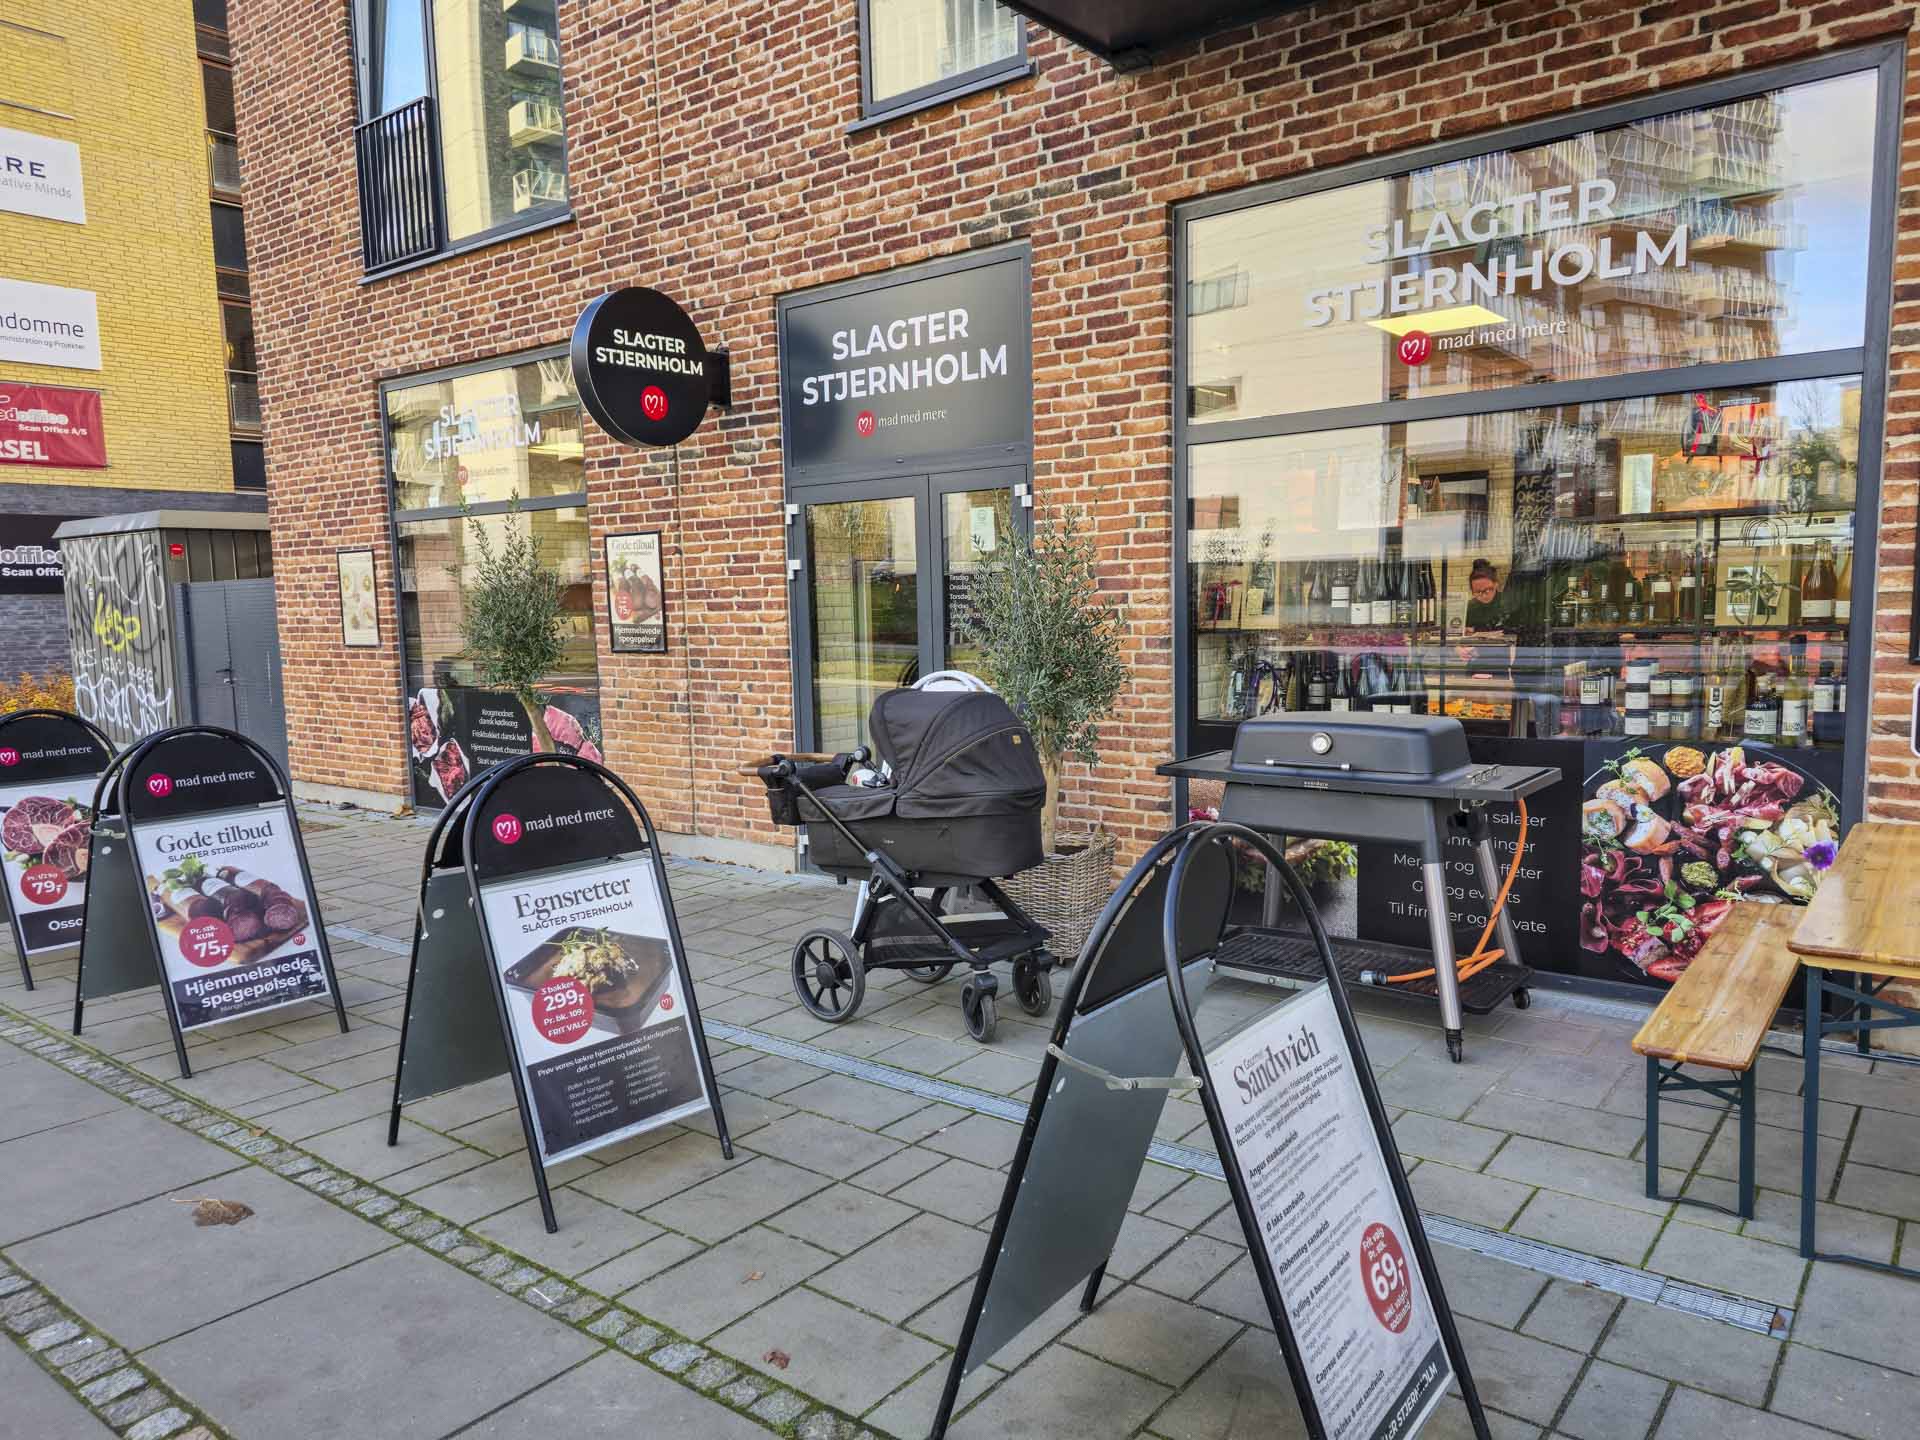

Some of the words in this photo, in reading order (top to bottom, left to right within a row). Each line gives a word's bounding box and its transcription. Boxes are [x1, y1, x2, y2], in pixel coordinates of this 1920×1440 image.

[0, 156, 46, 178] RE
[34, 182, 72, 199] Minds
[1361, 178, 1617, 264] SLAGTER
[1306, 224, 1689, 327] STJERNHOLM
[613, 328, 686, 354] SLAGTER
[832, 308, 969, 360] SLAGTER
[1438, 330, 1474, 350] mad
[1480, 324, 1516, 344] med
[1522, 318, 1567, 337] mere
[596, 346, 704, 377] STJERNHOLM
[802, 344, 1009, 406] STJERNHOLM
[878, 412, 898, 427] mad
[900, 409, 921, 425] med
[923, 407, 946, 422] mere
[2, 567, 33, 577] Scan
[36, 567, 64, 577] Offic
[22, 749, 43, 760] mad
[46, 747, 67, 757] med
[69, 745, 93, 755] mere
[175, 774, 201, 788] mad
[202, 771, 226, 784] med
[229, 769, 256, 780] mere
[525, 815, 553, 832] mad
[556, 810, 583, 827] med
[584, 808, 615, 820] mere
[156, 831, 213, 854] Gode
[217, 820, 273, 844] tilbud
[168, 850, 209, 863] SLAGTER
[211, 840, 270, 856] STJERNHOLM
[1455, 865, 1475, 875] og
[512, 878, 631, 921] Egnsretter
[1446, 886, 1465, 899] og
[522, 915, 568, 933] SLAGTER
[570, 901, 633, 922] STJERNHOLM
[1388, 902, 1404, 915] Til
[1467, 914, 1487, 927] og
[184, 955, 313, 997] Hjemmelavede
[201, 974, 302, 1010] spegepølser
[566, 1019, 589, 1031] VALG
[1233, 1024, 1320, 1104] Sandwich
[1249, 1161, 1266, 1179] Angus
[1283, 1191, 1306, 1216] sandwich
[1280, 1243, 1308, 1275] Ribbensteg
[1307, 1220, 1330, 1246] sandwich
